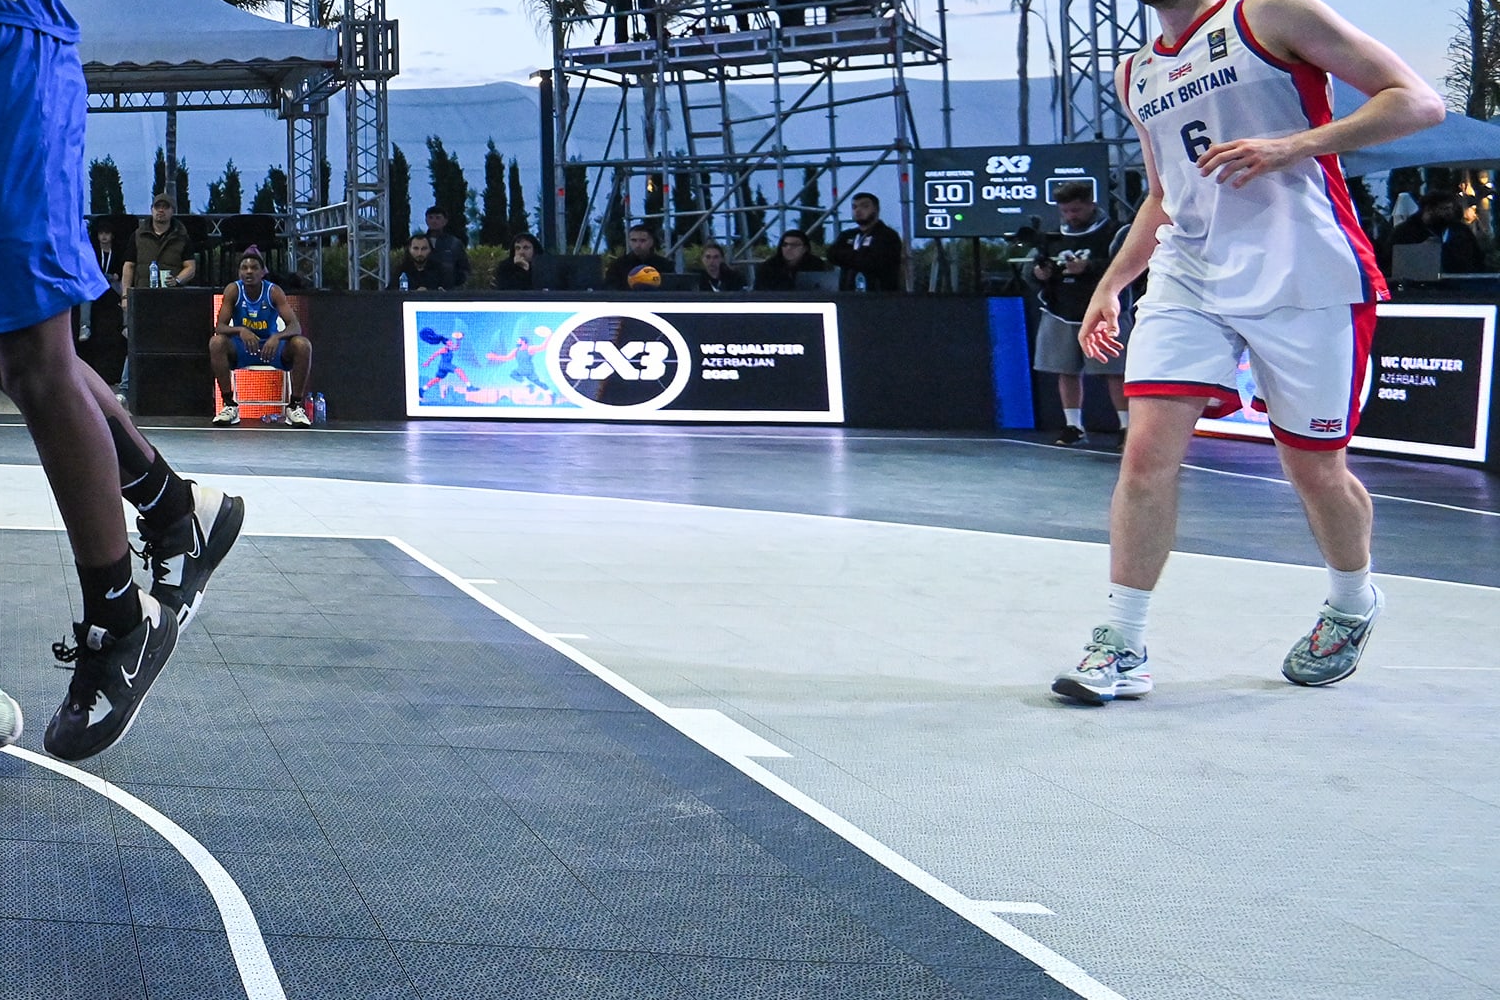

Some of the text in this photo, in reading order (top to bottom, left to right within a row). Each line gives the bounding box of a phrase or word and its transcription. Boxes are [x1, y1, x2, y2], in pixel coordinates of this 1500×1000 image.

[1138, 66, 1238, 122] GREAT BRITAIN
[1181, 120, 1213, 164] 6
[934, 184, 963, 202] 10
[982, 185, 1037, 200] 04:03
[700, 344, 804, 356] WC QUALIFIER
[566, 341, 669, 380] 3X3
[702, 358, 775, 367] AZERBAIJAN
[1381, 356, 1463, 372] WC QUALIFIER
[1380, 373, 1436, 387] AZERBAIJAN
[1378, 387, 1406, 401] 2025
